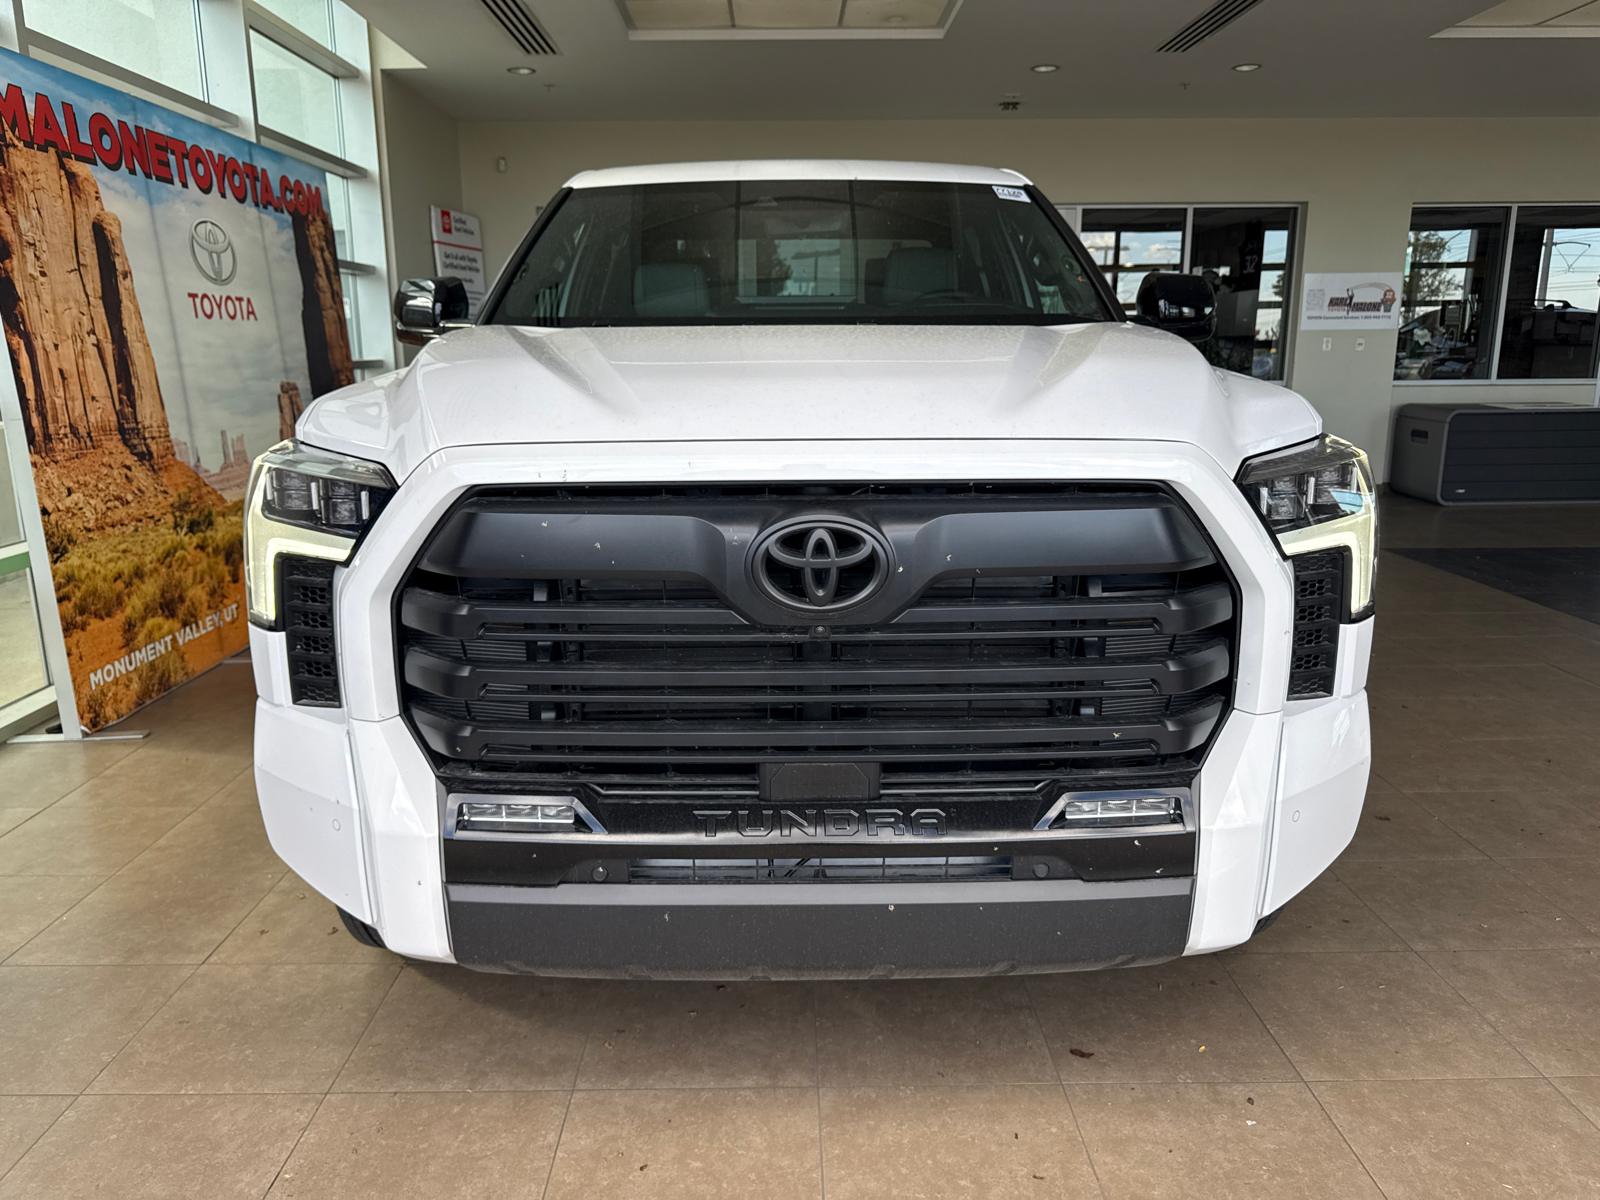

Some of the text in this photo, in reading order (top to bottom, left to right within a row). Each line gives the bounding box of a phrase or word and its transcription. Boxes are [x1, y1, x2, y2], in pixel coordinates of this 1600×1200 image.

[0, 83, 326, 218] MALONETOYOTA.COM
[187, 292, 258, 321] TOYOTA
[1328, 297, 1349, 306] KARL
[1351, 302, 1382, 312] MALONE
[89, 603, 238, 690] MONUMENT VALLEY, UT
[692, 808, 949, 838] TUNDRA
